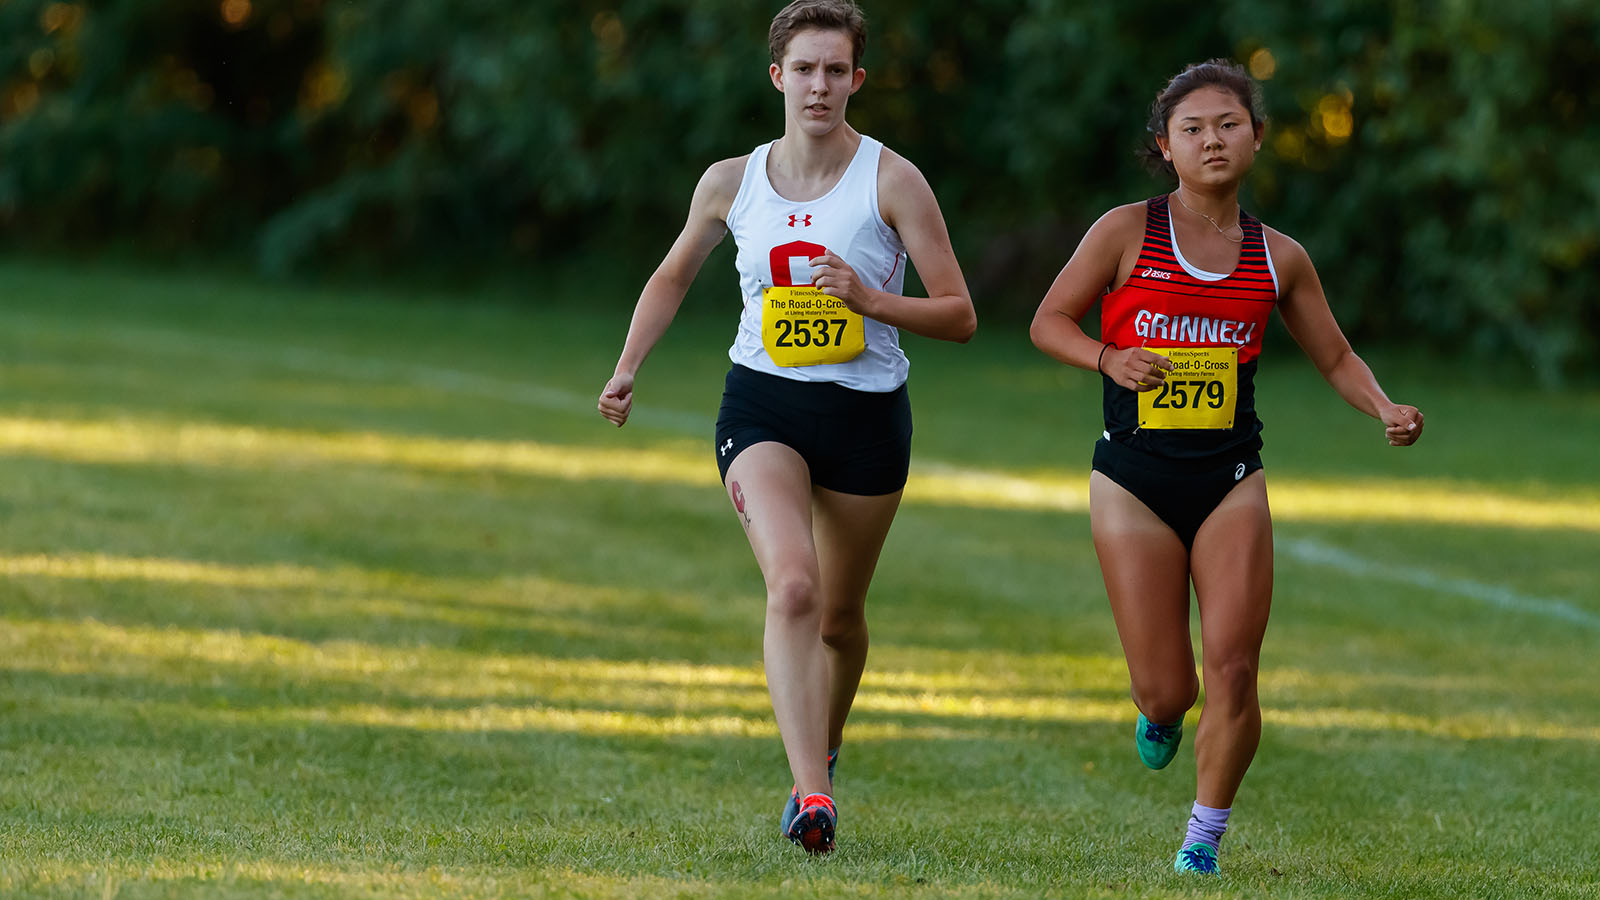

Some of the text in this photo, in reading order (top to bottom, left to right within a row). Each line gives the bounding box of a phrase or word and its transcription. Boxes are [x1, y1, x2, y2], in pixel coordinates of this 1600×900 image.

[1151, 270, 1171, 280] asics
[770, 299, 847, 309] The Road-O-Cros
[775, 319, 848, 347] 2537
[1169, 350, 1210, 358] FitnessSports
[1152, 380, 1225, 409] 2579
